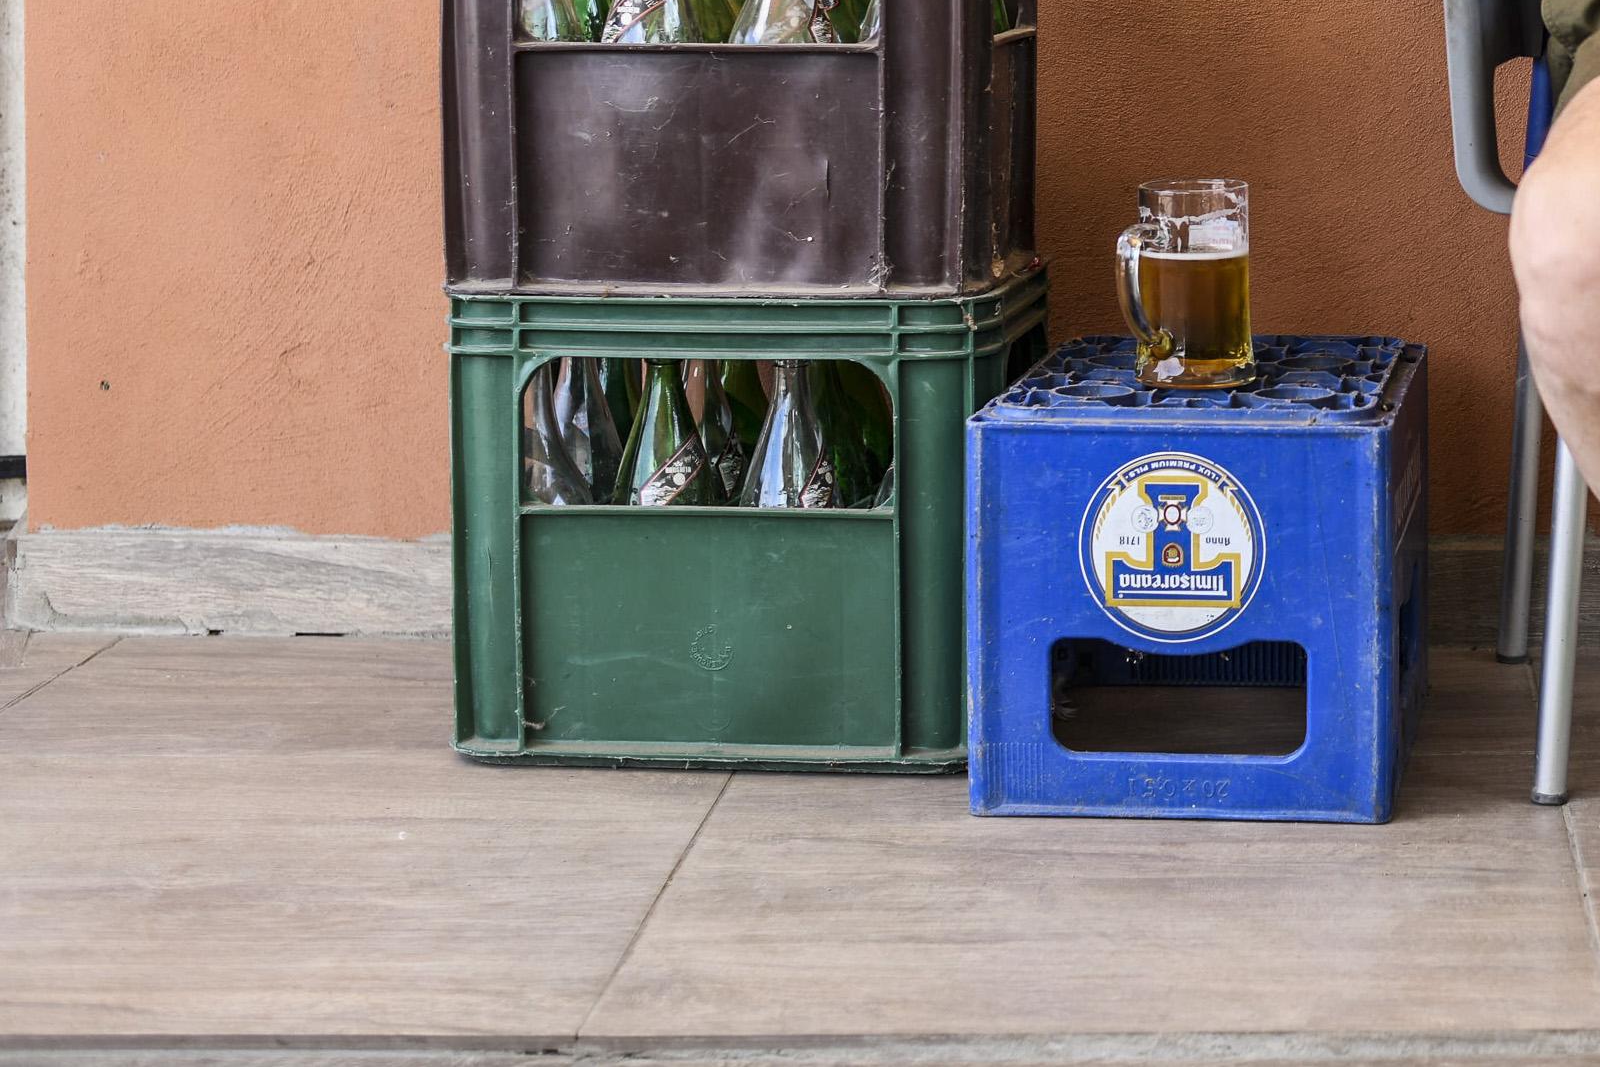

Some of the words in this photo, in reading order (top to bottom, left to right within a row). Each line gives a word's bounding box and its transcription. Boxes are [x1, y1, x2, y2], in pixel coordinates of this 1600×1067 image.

[1128, 464, 1149, 478] PILS
[1150, 459, 1197, 472] PREMIUM
[1197, 464, 1216, 480] LUX
[1119, 535, 1140, 547] 1718
[1205, 536, 1231, 547] Anno
